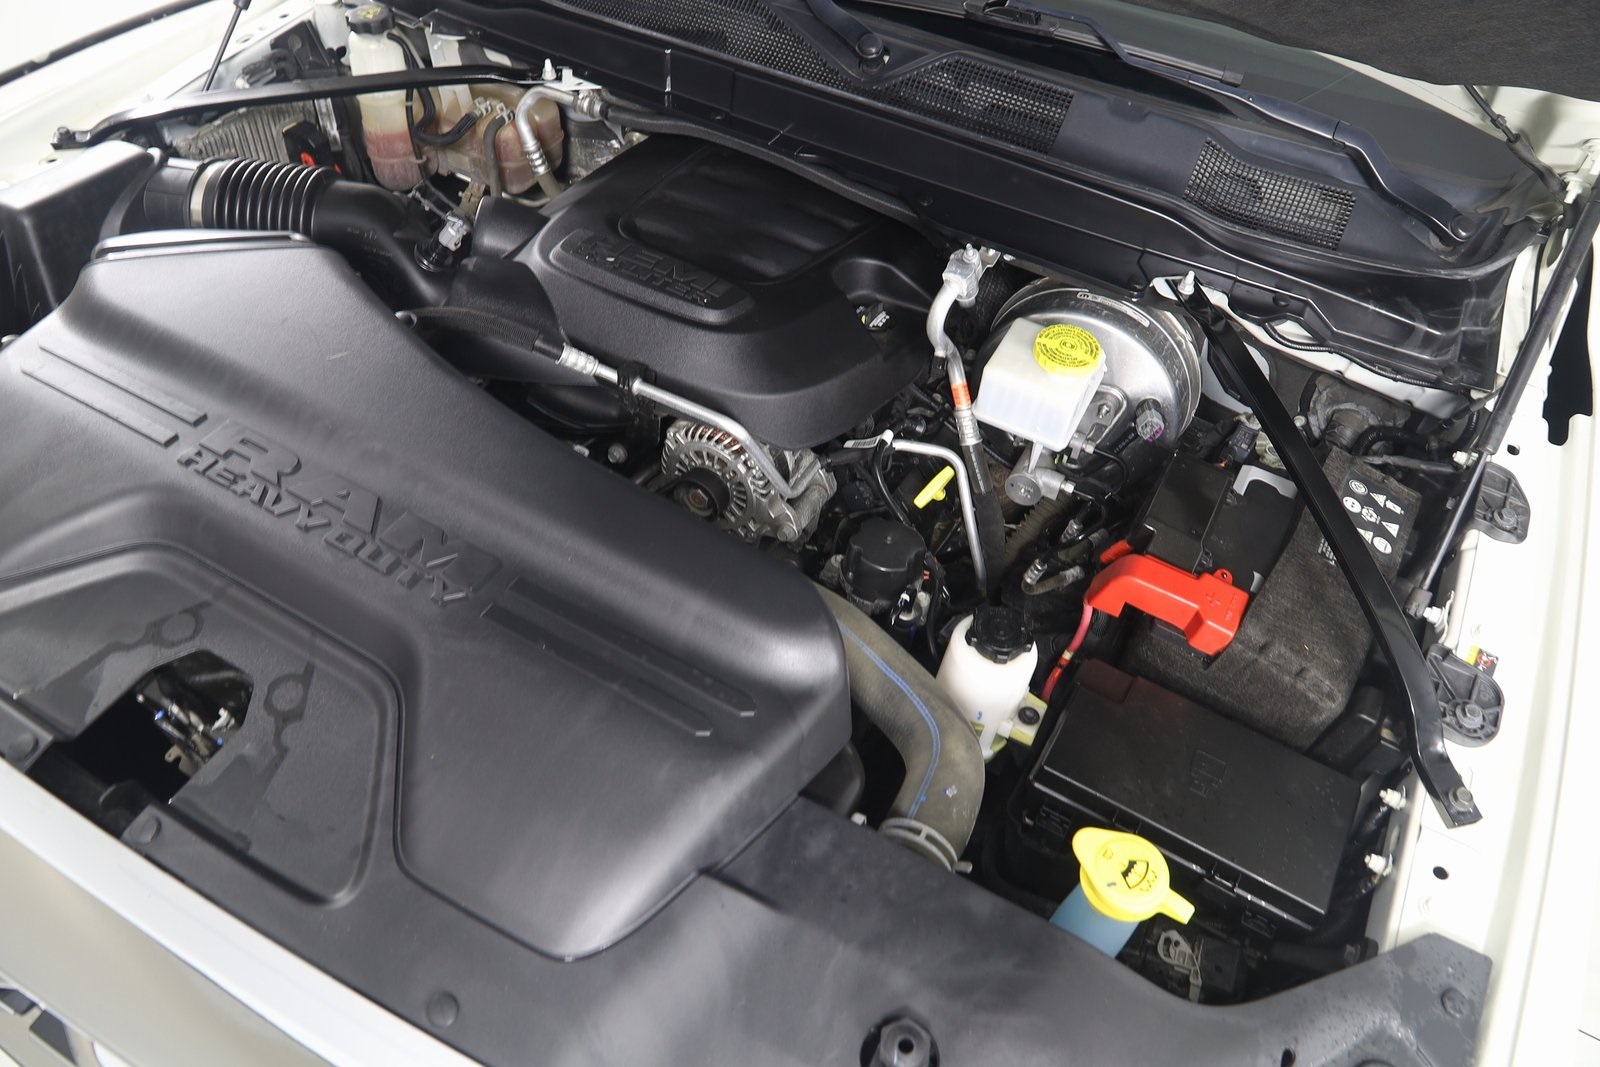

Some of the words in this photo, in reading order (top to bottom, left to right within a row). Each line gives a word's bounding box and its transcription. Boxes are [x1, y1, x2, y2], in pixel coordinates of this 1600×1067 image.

[576, 231, 734, 299] HEMI
[177, 448, 332, 533] HEAVY
[322, 525, 470, 604] DUTY
[198, 418, 503, 593] RAM
